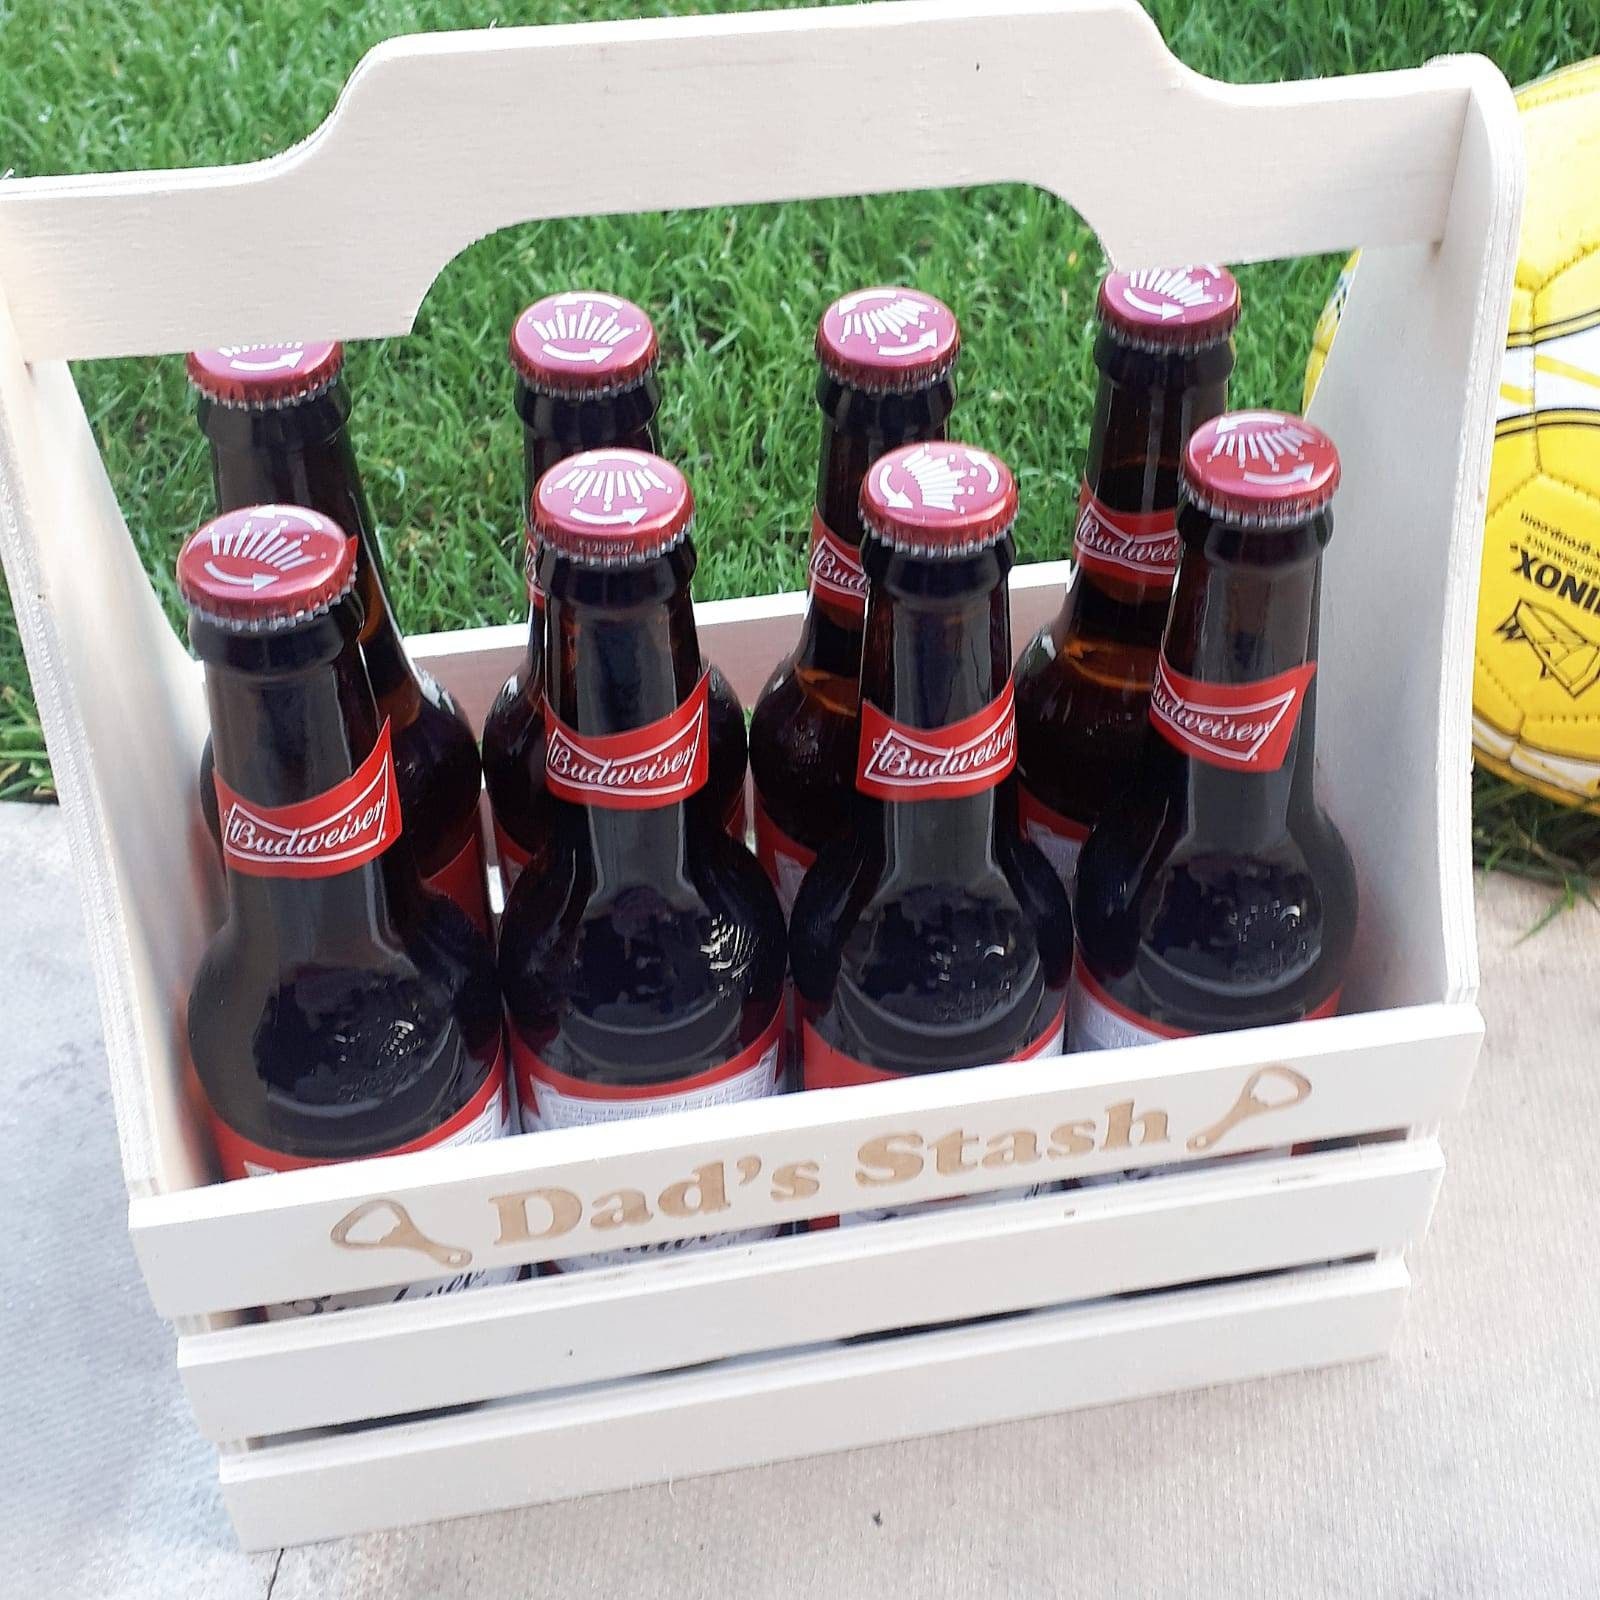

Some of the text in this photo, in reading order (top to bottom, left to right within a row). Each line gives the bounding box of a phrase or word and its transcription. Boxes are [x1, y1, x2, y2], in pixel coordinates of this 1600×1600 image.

[1079, 513, 1178, 562] Budwei
[549, 742, 698, 787] Budweiser
[225, 796, 387, 857] Budweiser
[488, 1154, 821, 1248] Dad's
[853, 1099, 1172, 1188] Stash
